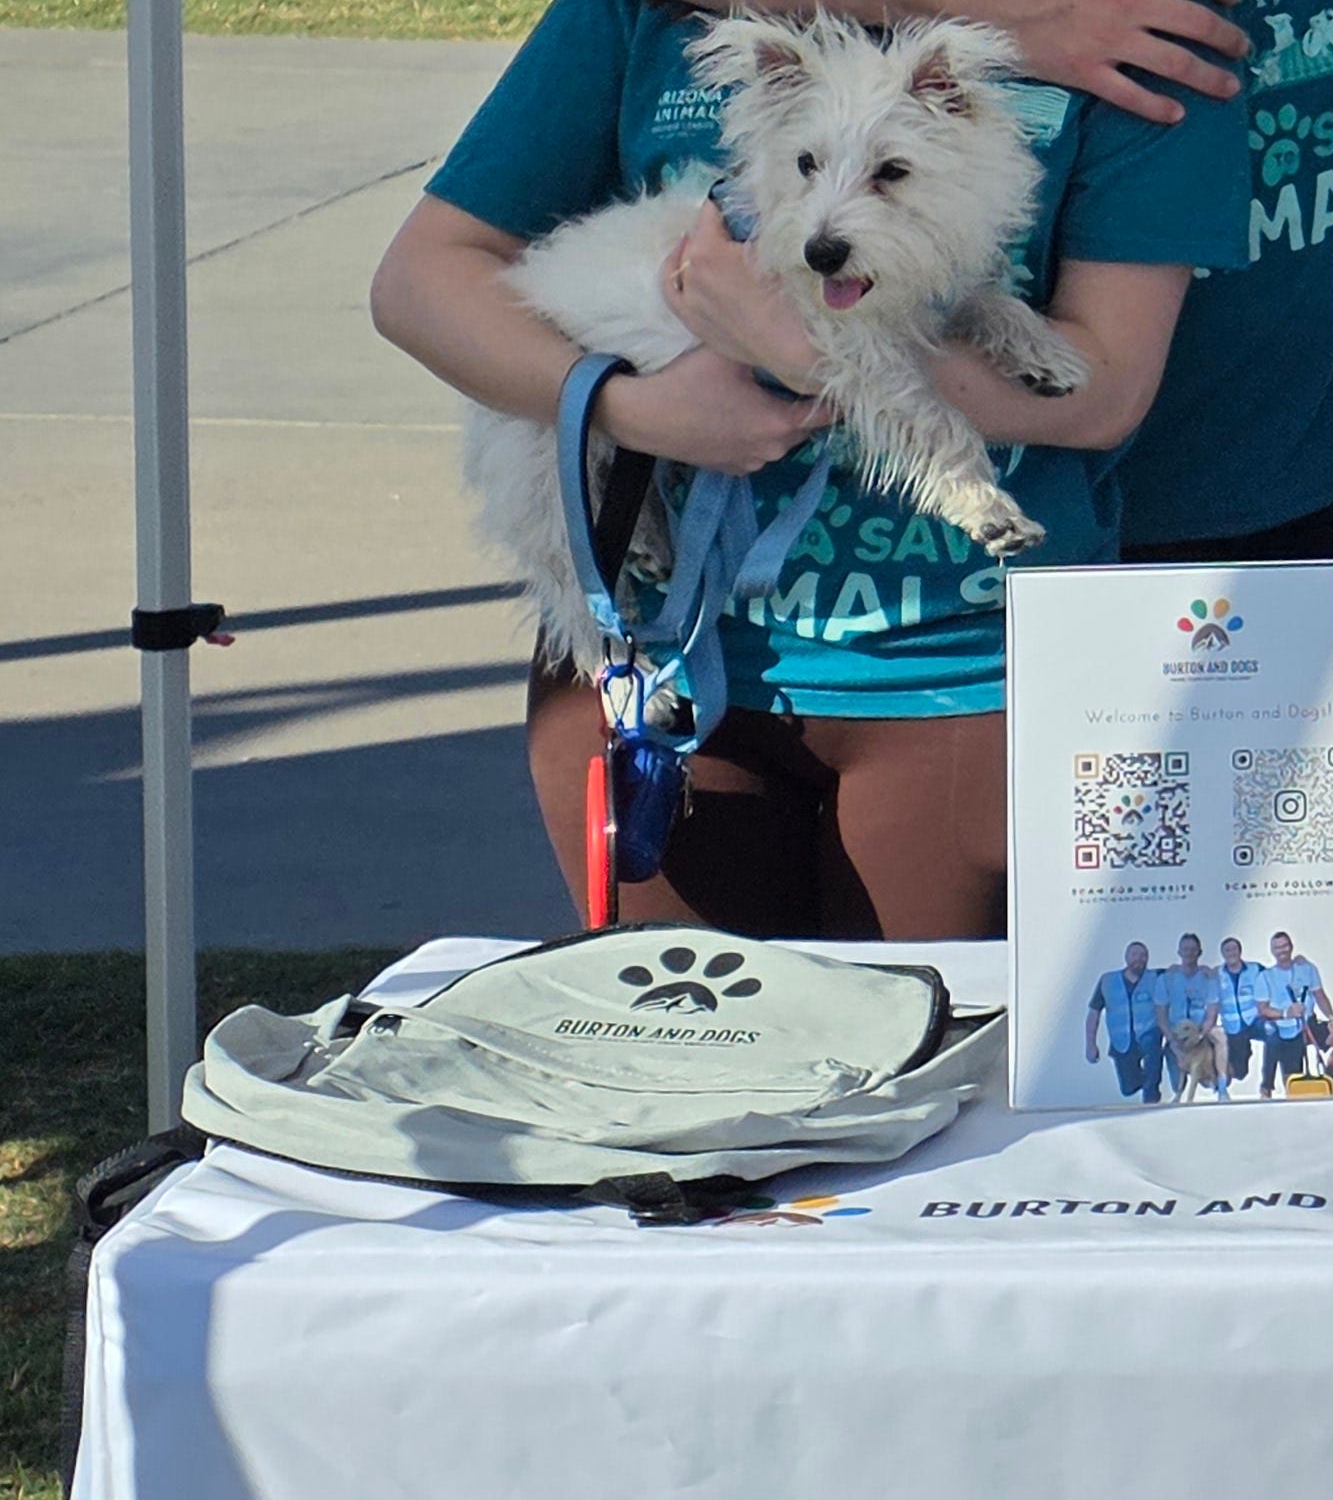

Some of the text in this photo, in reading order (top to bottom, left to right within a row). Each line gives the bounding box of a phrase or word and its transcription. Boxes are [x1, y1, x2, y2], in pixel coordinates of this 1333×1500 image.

[854, 515, 972, 564] SAV
[1162, 659, 1259, 676] BURTON AND DOGS
[1084, 702, 1333, 725] Welcome to Burton and Dogs!
[1284, 879, 1333, 890] FOLLOW
[554, 1018, 647, 1039] BURTON
[649, 1026, 697, 1041] AND
[700, 1028, 761, 1045] DOGS
[919, 1199, 1178, 1219] BURTON
[1195, 1192, 1328, 1216] AND
